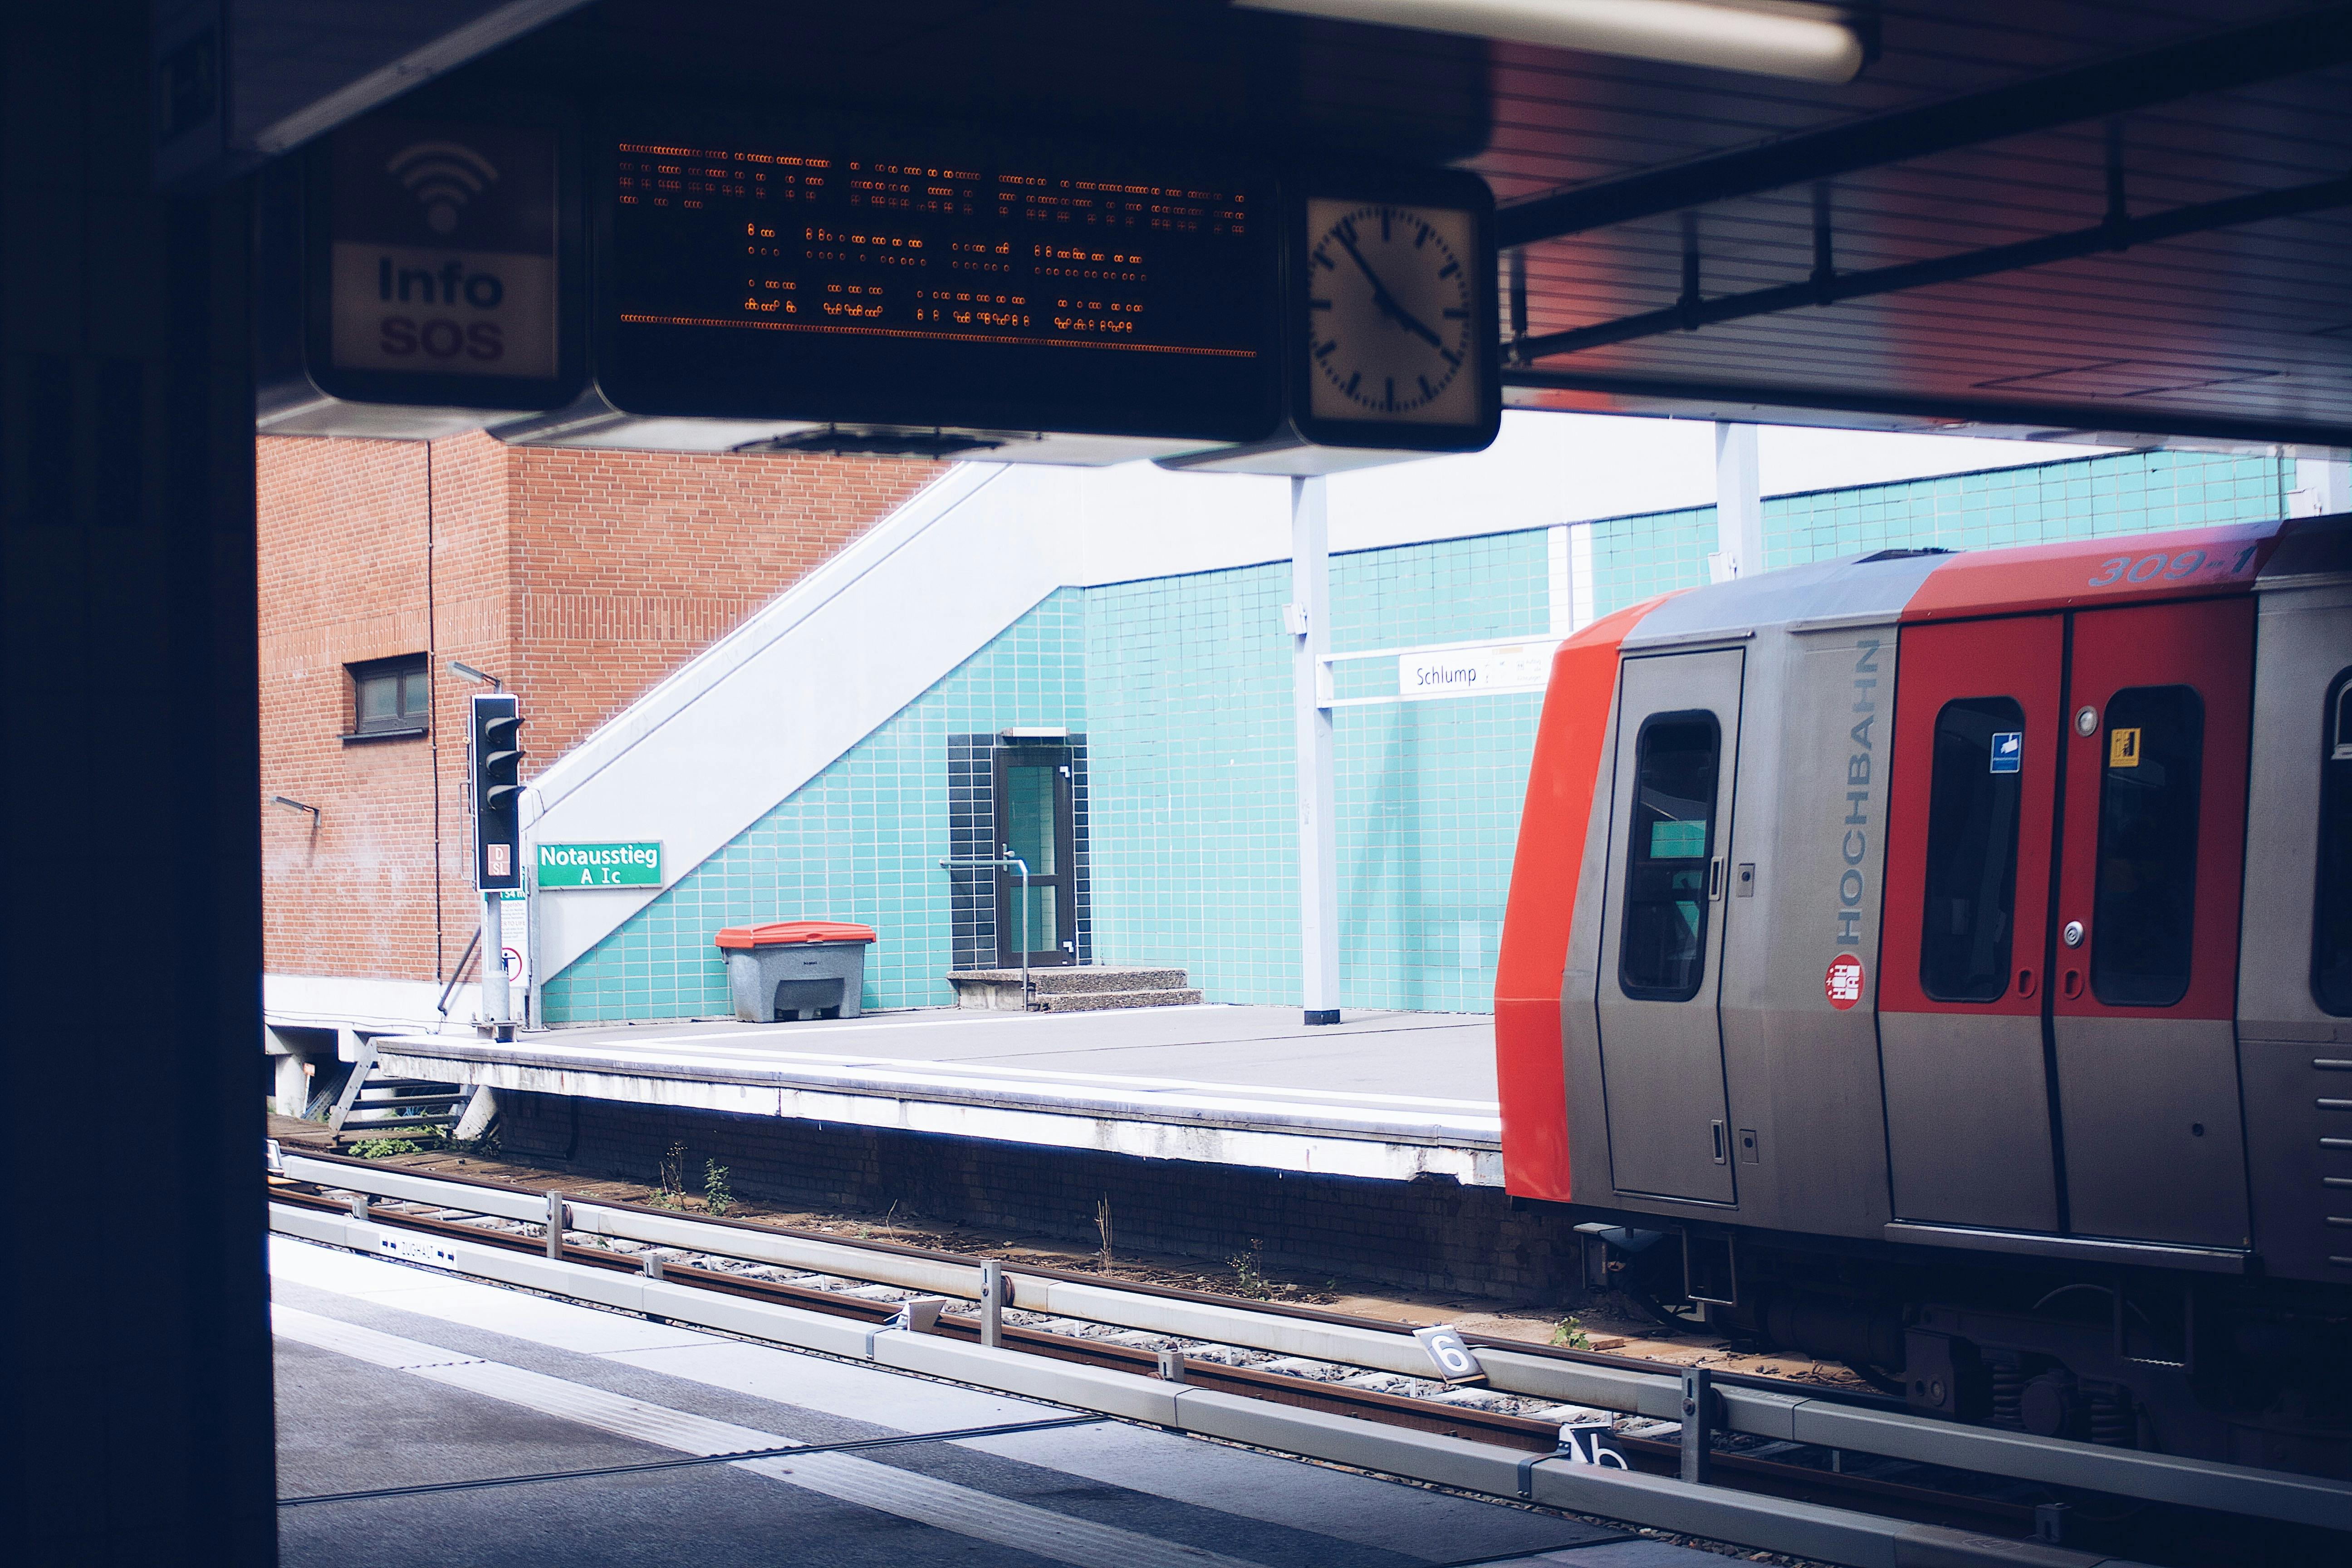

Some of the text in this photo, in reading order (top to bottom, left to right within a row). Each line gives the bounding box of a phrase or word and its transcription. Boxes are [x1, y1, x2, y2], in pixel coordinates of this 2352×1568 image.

[379, 256, 504, 309] Info
[379, 317, 505, 363] SOS
[2088, 545, 2259, 587] 309-1
[1417, 665, 1476, 686] Schlump
[1837, 639, 1881, 946] HOCHBAHN
[493, 862, 507, 876] SL
[495, 847, 504, 861] D
[540, 844, 657, 869] Notausstieg
[580, 867, 593, 884] A
[1431, 1335, 1469, 1372] 6
